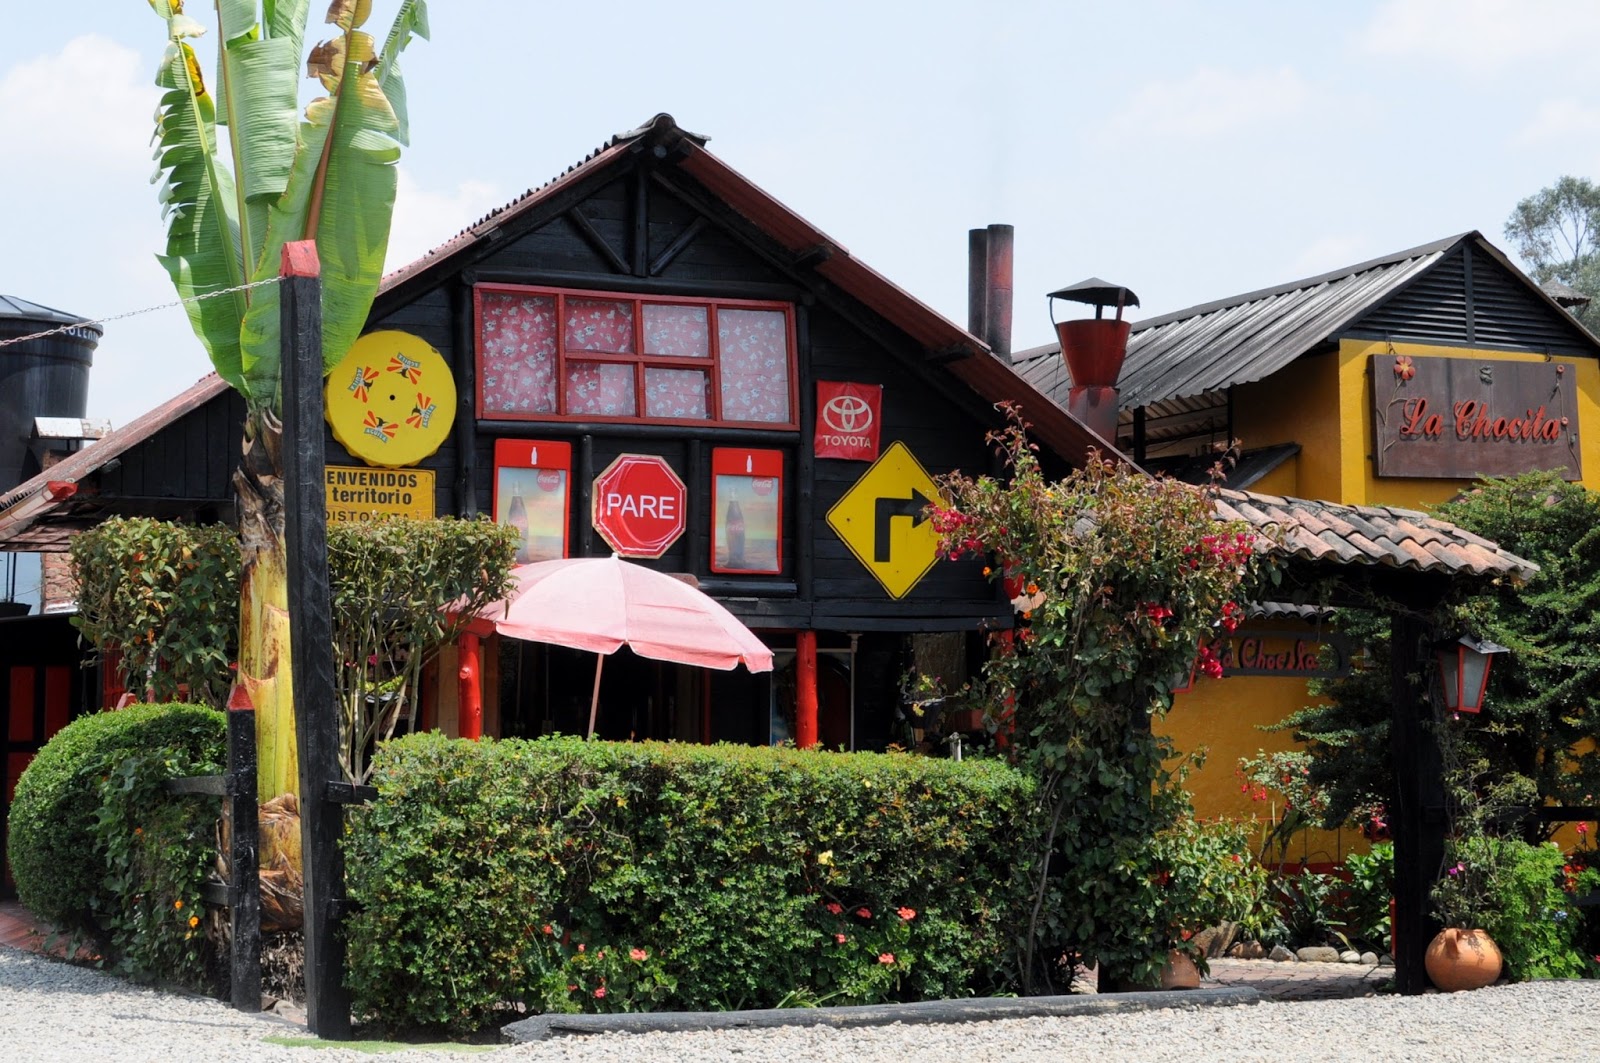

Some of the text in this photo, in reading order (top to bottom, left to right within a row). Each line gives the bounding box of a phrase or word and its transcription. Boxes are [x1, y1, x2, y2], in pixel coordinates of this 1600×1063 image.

[1400, 397, 1560, 440] La Chocita
[822, 434, 871, 448] TOYOTA
[332, 487, 412, 505] territorio
[606, 493, 675, 520] PARE
